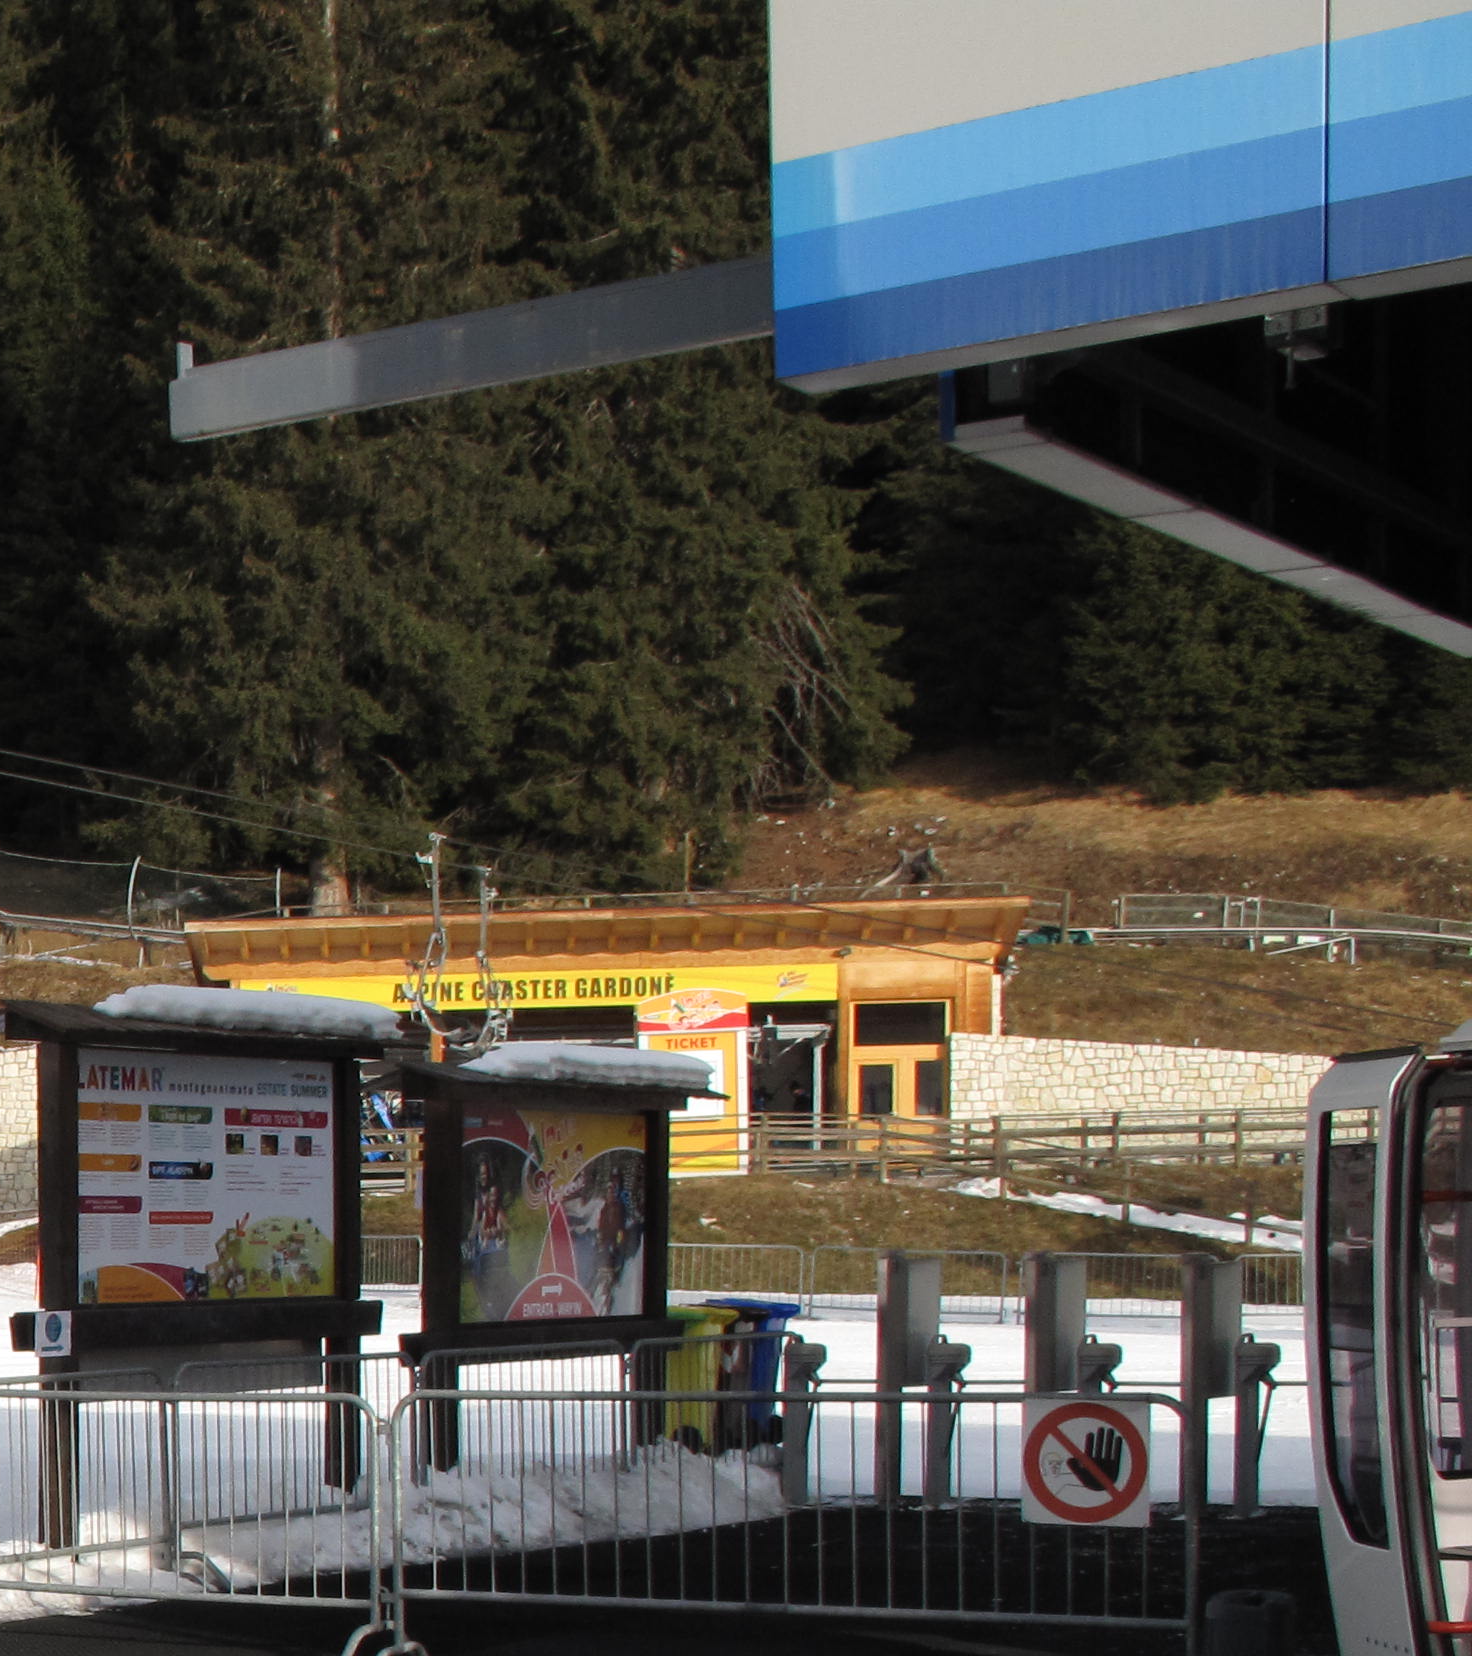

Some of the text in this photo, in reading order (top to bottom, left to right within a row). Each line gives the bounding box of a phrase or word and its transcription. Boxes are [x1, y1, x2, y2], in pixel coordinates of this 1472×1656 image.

[666, 1037, 717, 1049] TICKET
[257, 1082, 287, 1097] ESTATE
[291, 1084, 328, 1098] SUMMER
